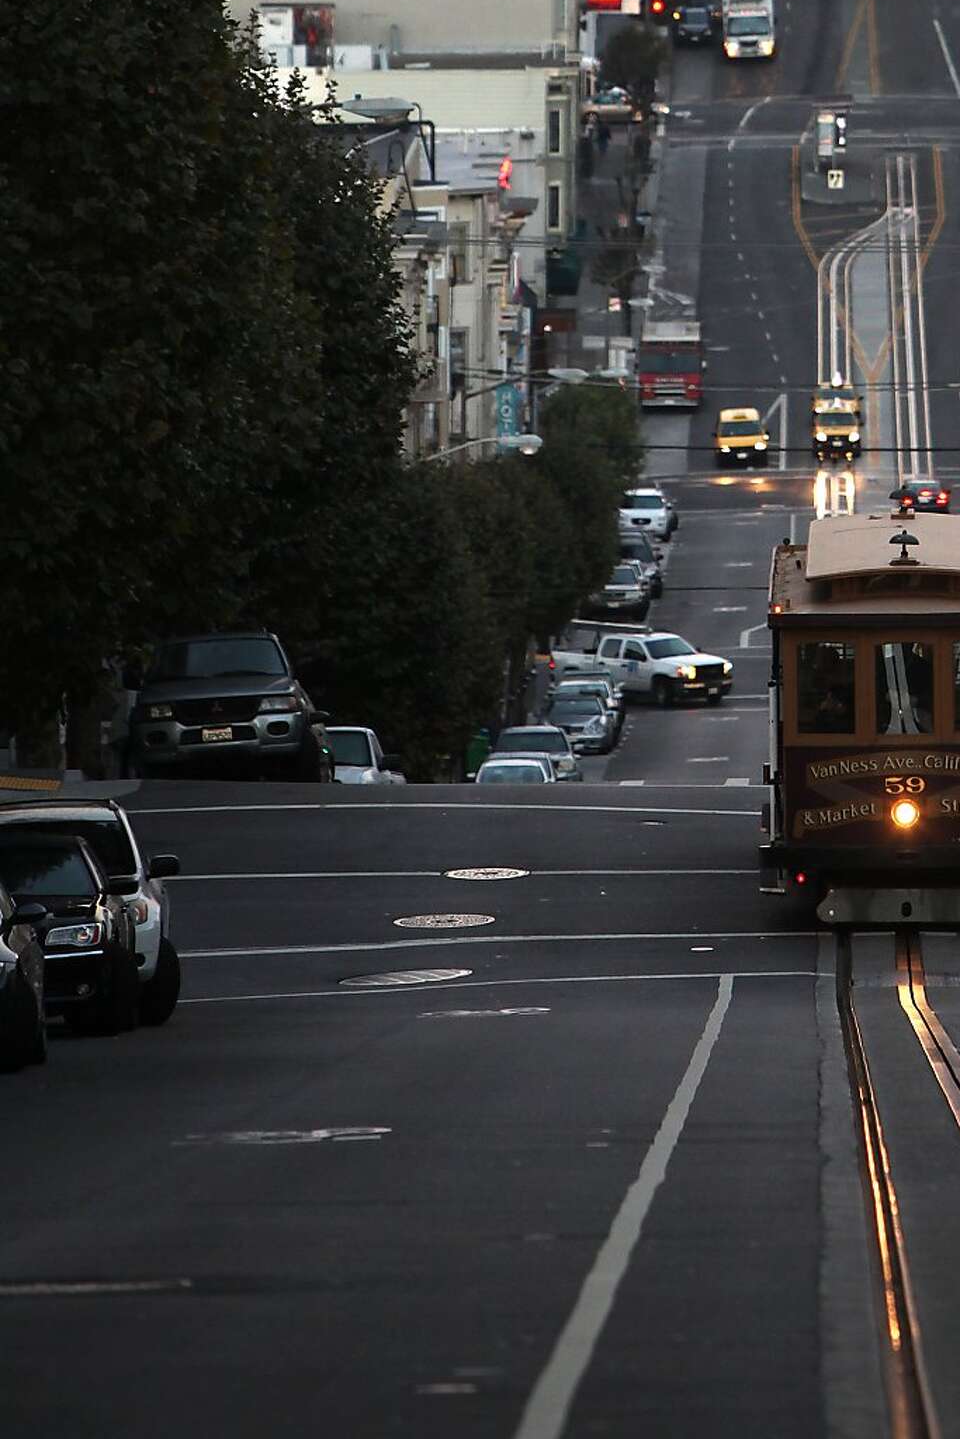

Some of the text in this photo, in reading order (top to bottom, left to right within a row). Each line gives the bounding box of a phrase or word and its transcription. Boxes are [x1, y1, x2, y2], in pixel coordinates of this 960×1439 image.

[810, 763, 838, 779] Van
[839, 758, 878, 775] Ness
[884, 776, 926, 794] 59
[803, 810, 815, 825] &
[819, 802, 876, 824] Market
